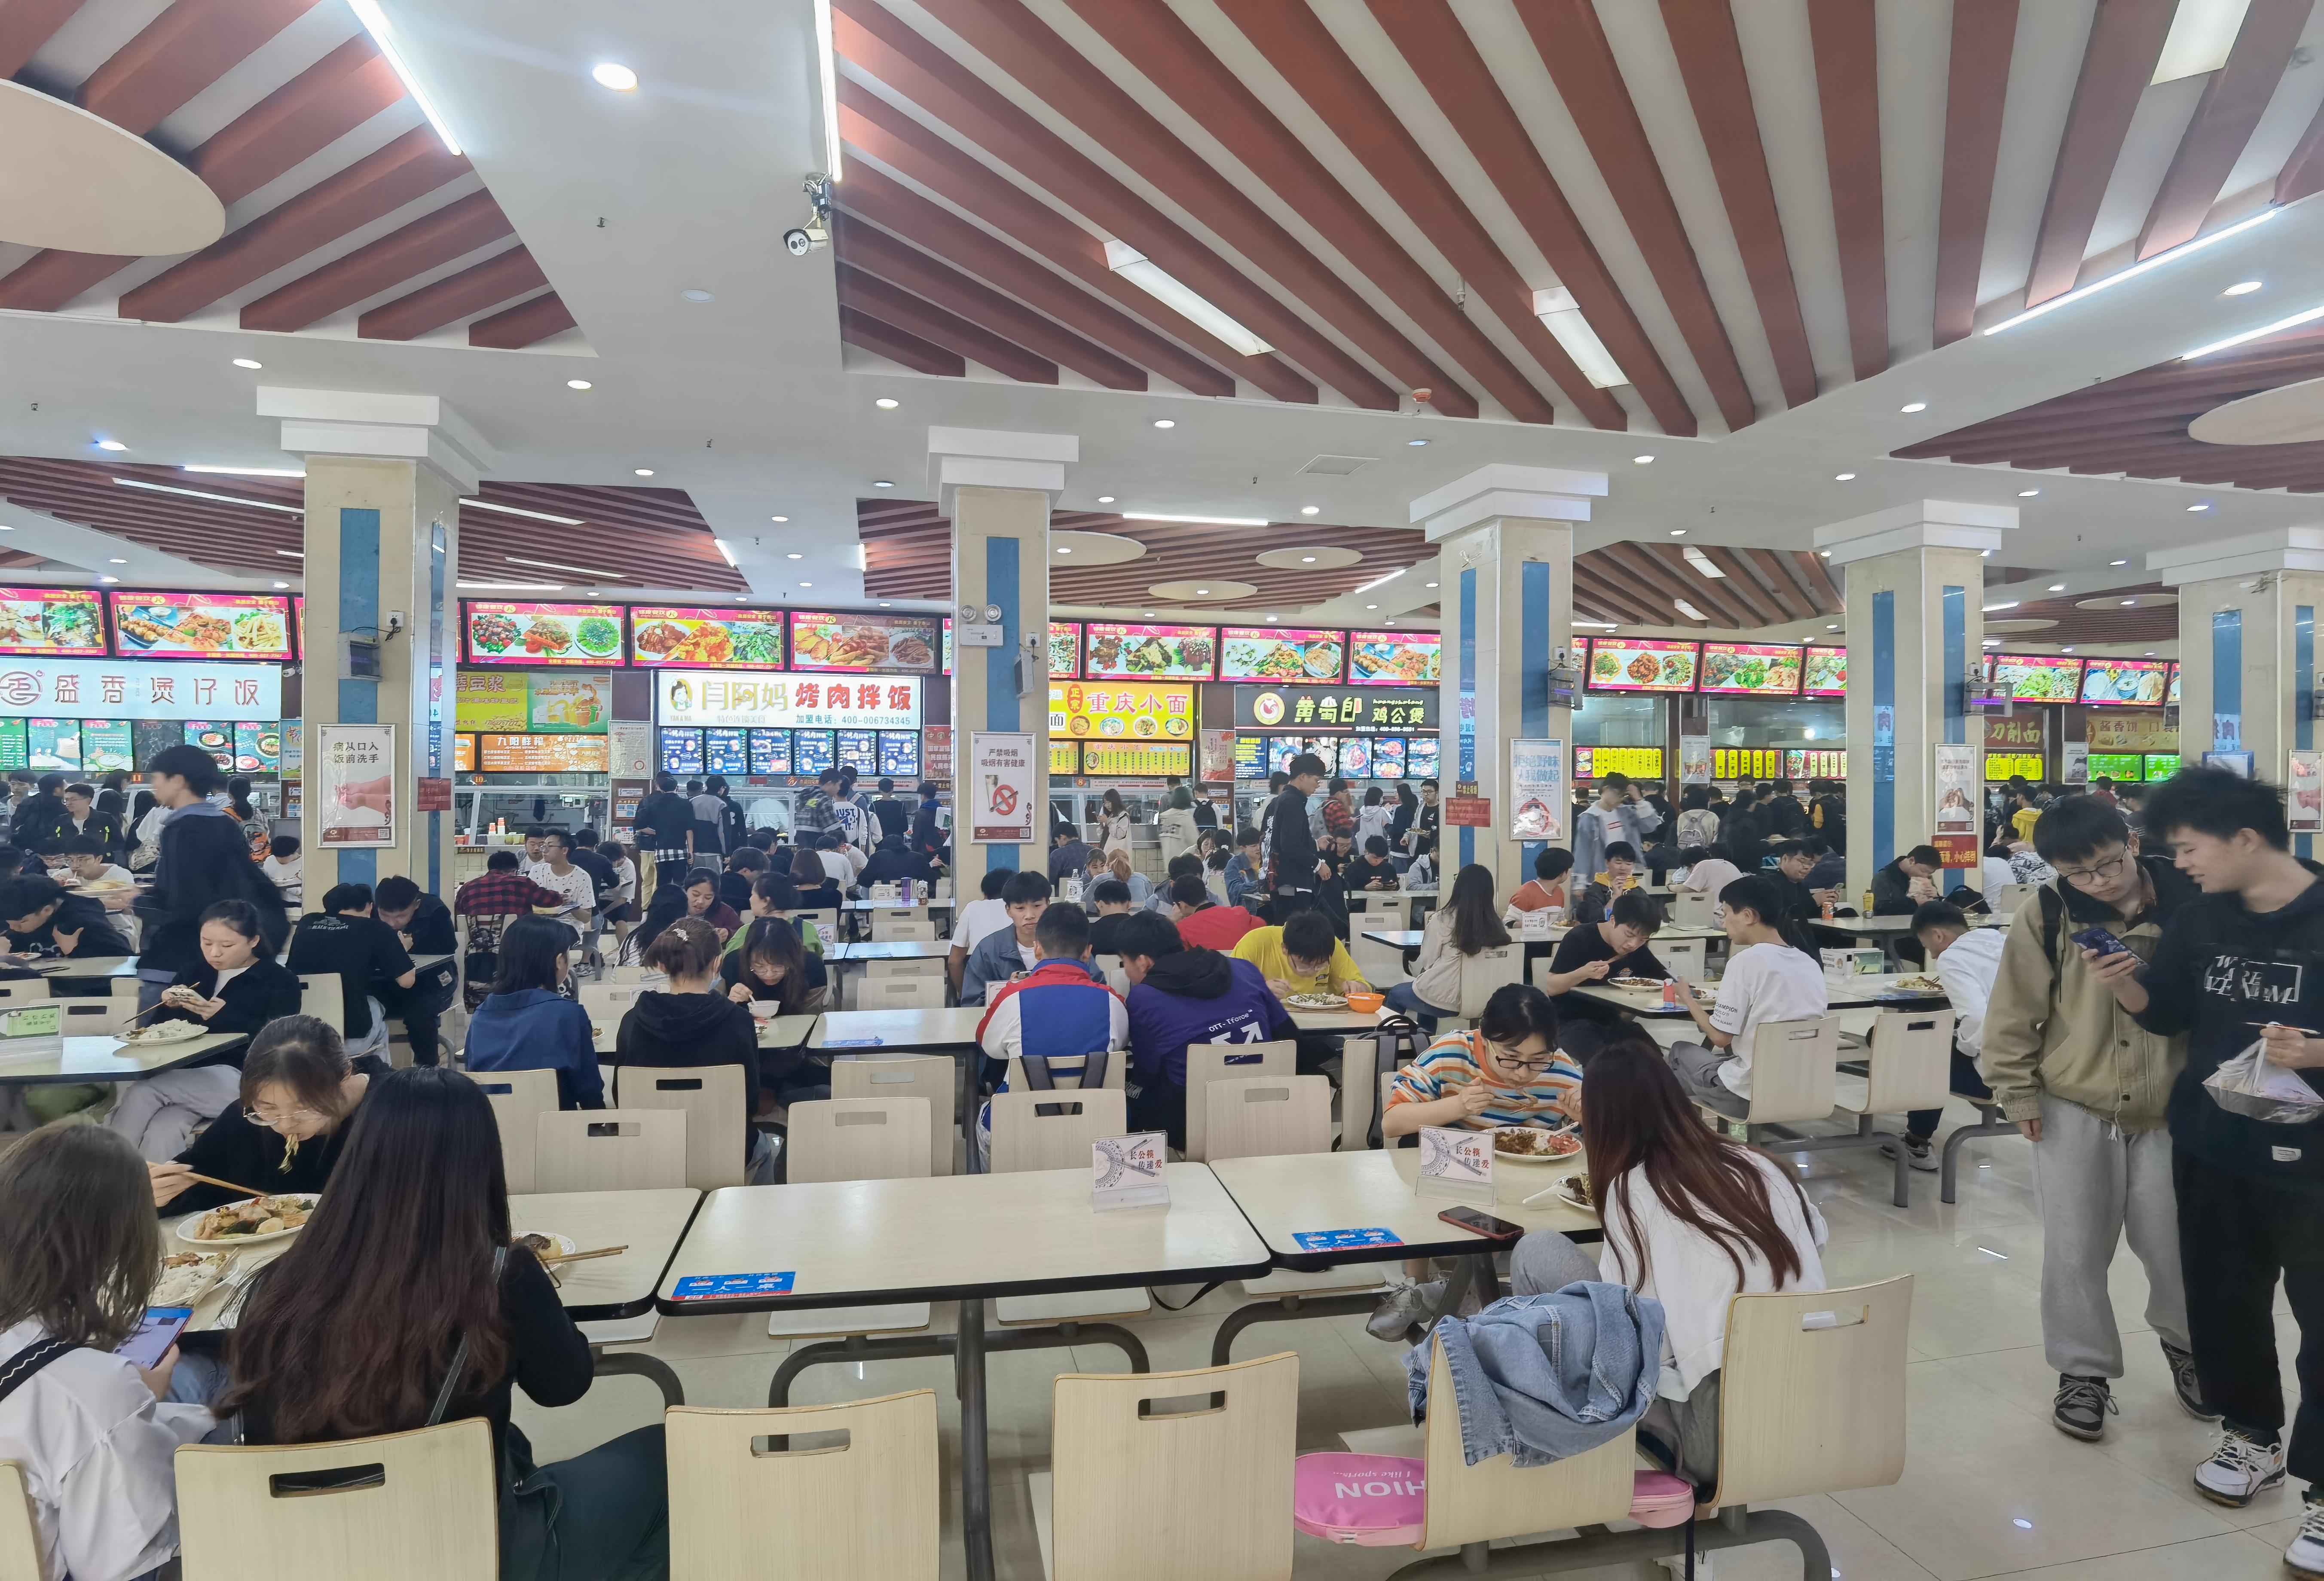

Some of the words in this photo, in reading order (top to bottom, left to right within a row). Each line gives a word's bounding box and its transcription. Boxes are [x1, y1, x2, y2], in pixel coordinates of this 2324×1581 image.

[55, 674, 260, 705] 盛香煲仔饭
[702, 681, 788, 711] 闫阿妈
[795, 683, 911, 710] 烤肉拌饭
[1071, 688, 1080, 710] 正宗
[1087, 692, 1187, 714] 重庆小面
[1293, 695, 1363, 723] 黄蜀郎
[1372, 706, 1425, 724] 鸡公煲
[1990, 721, 2040, 744] 刀削面
[333, 742, 379, 752] 病从口入
[988, 748, 1018, 757] 严禁吸烟
[333, 754, 379, 764] 饭前洗手
[981, 759, 1025, 767] 吸烟有害健康
[1514, 754, 1560, 767] 拒绝野味
[835, 809, 854, 817] JUST
